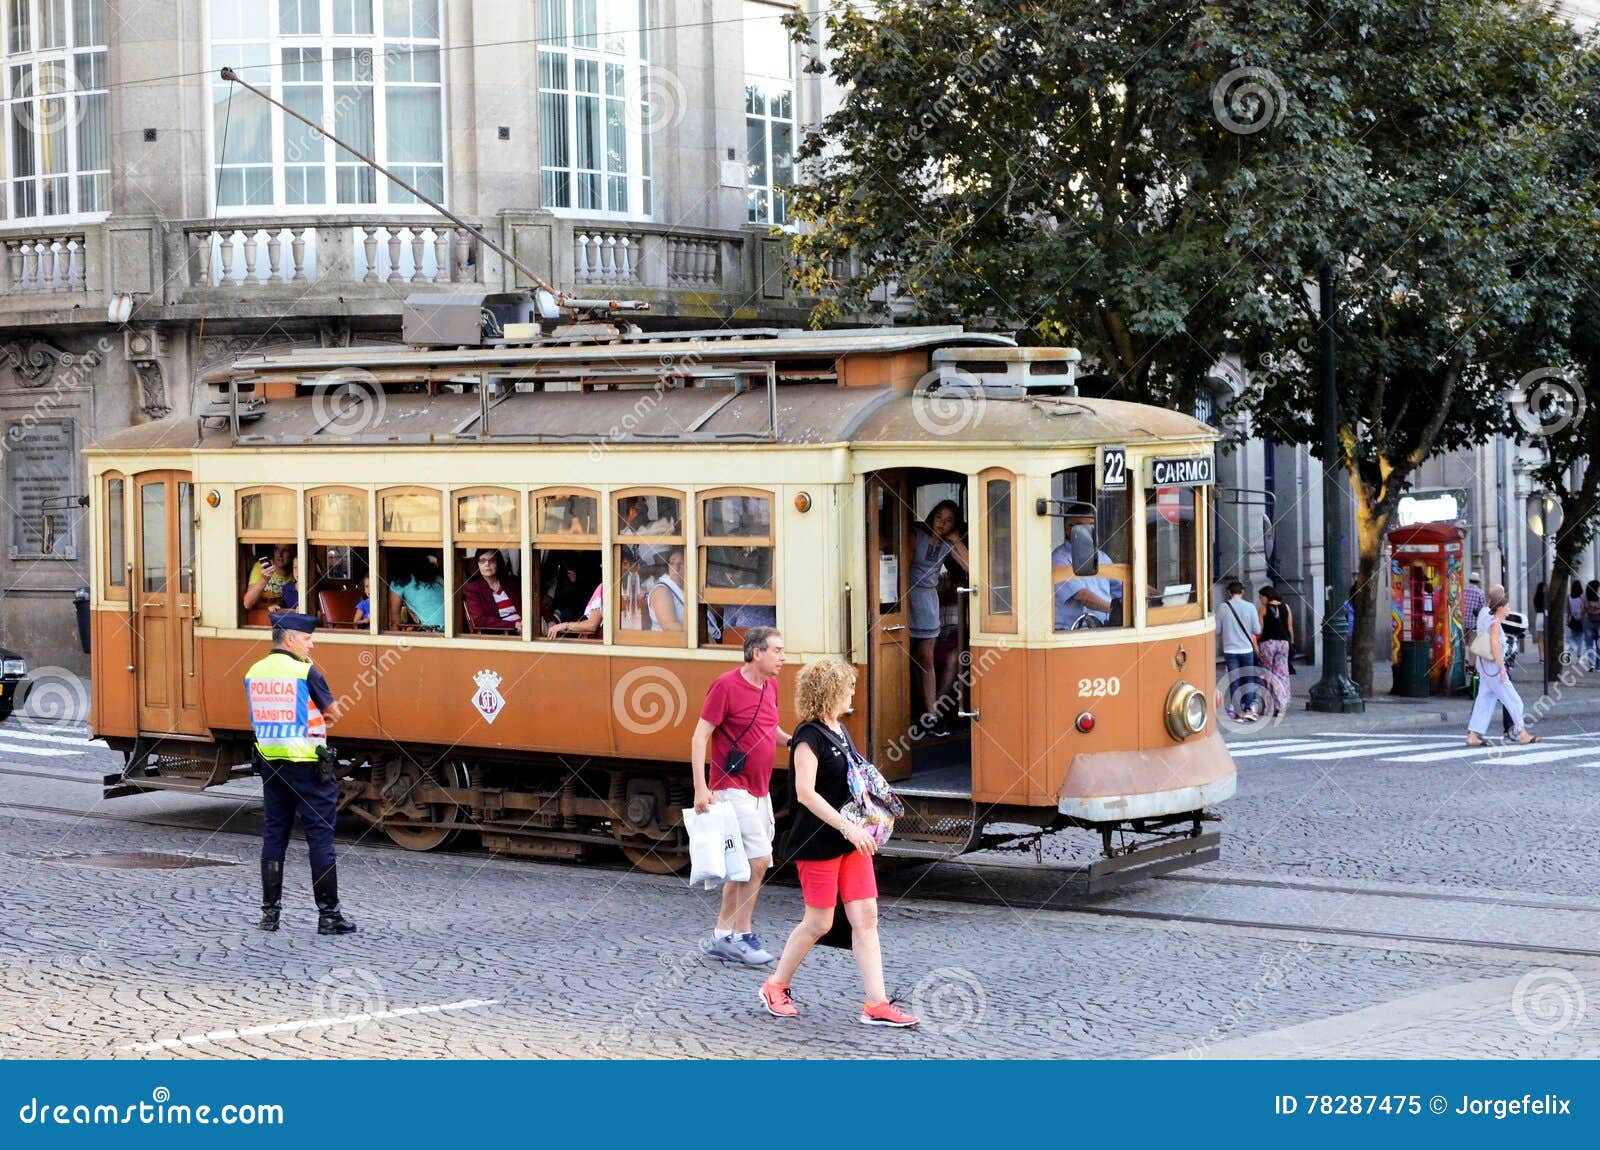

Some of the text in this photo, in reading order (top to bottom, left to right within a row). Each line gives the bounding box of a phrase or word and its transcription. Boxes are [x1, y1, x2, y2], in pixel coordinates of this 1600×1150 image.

[1105, 452, 1124, 484] 22
[1155, 460, 1209, 483] CARMO
[250, 679, 295, 696] POLÍCIA
[1078, 676, 1120, 697] 220
